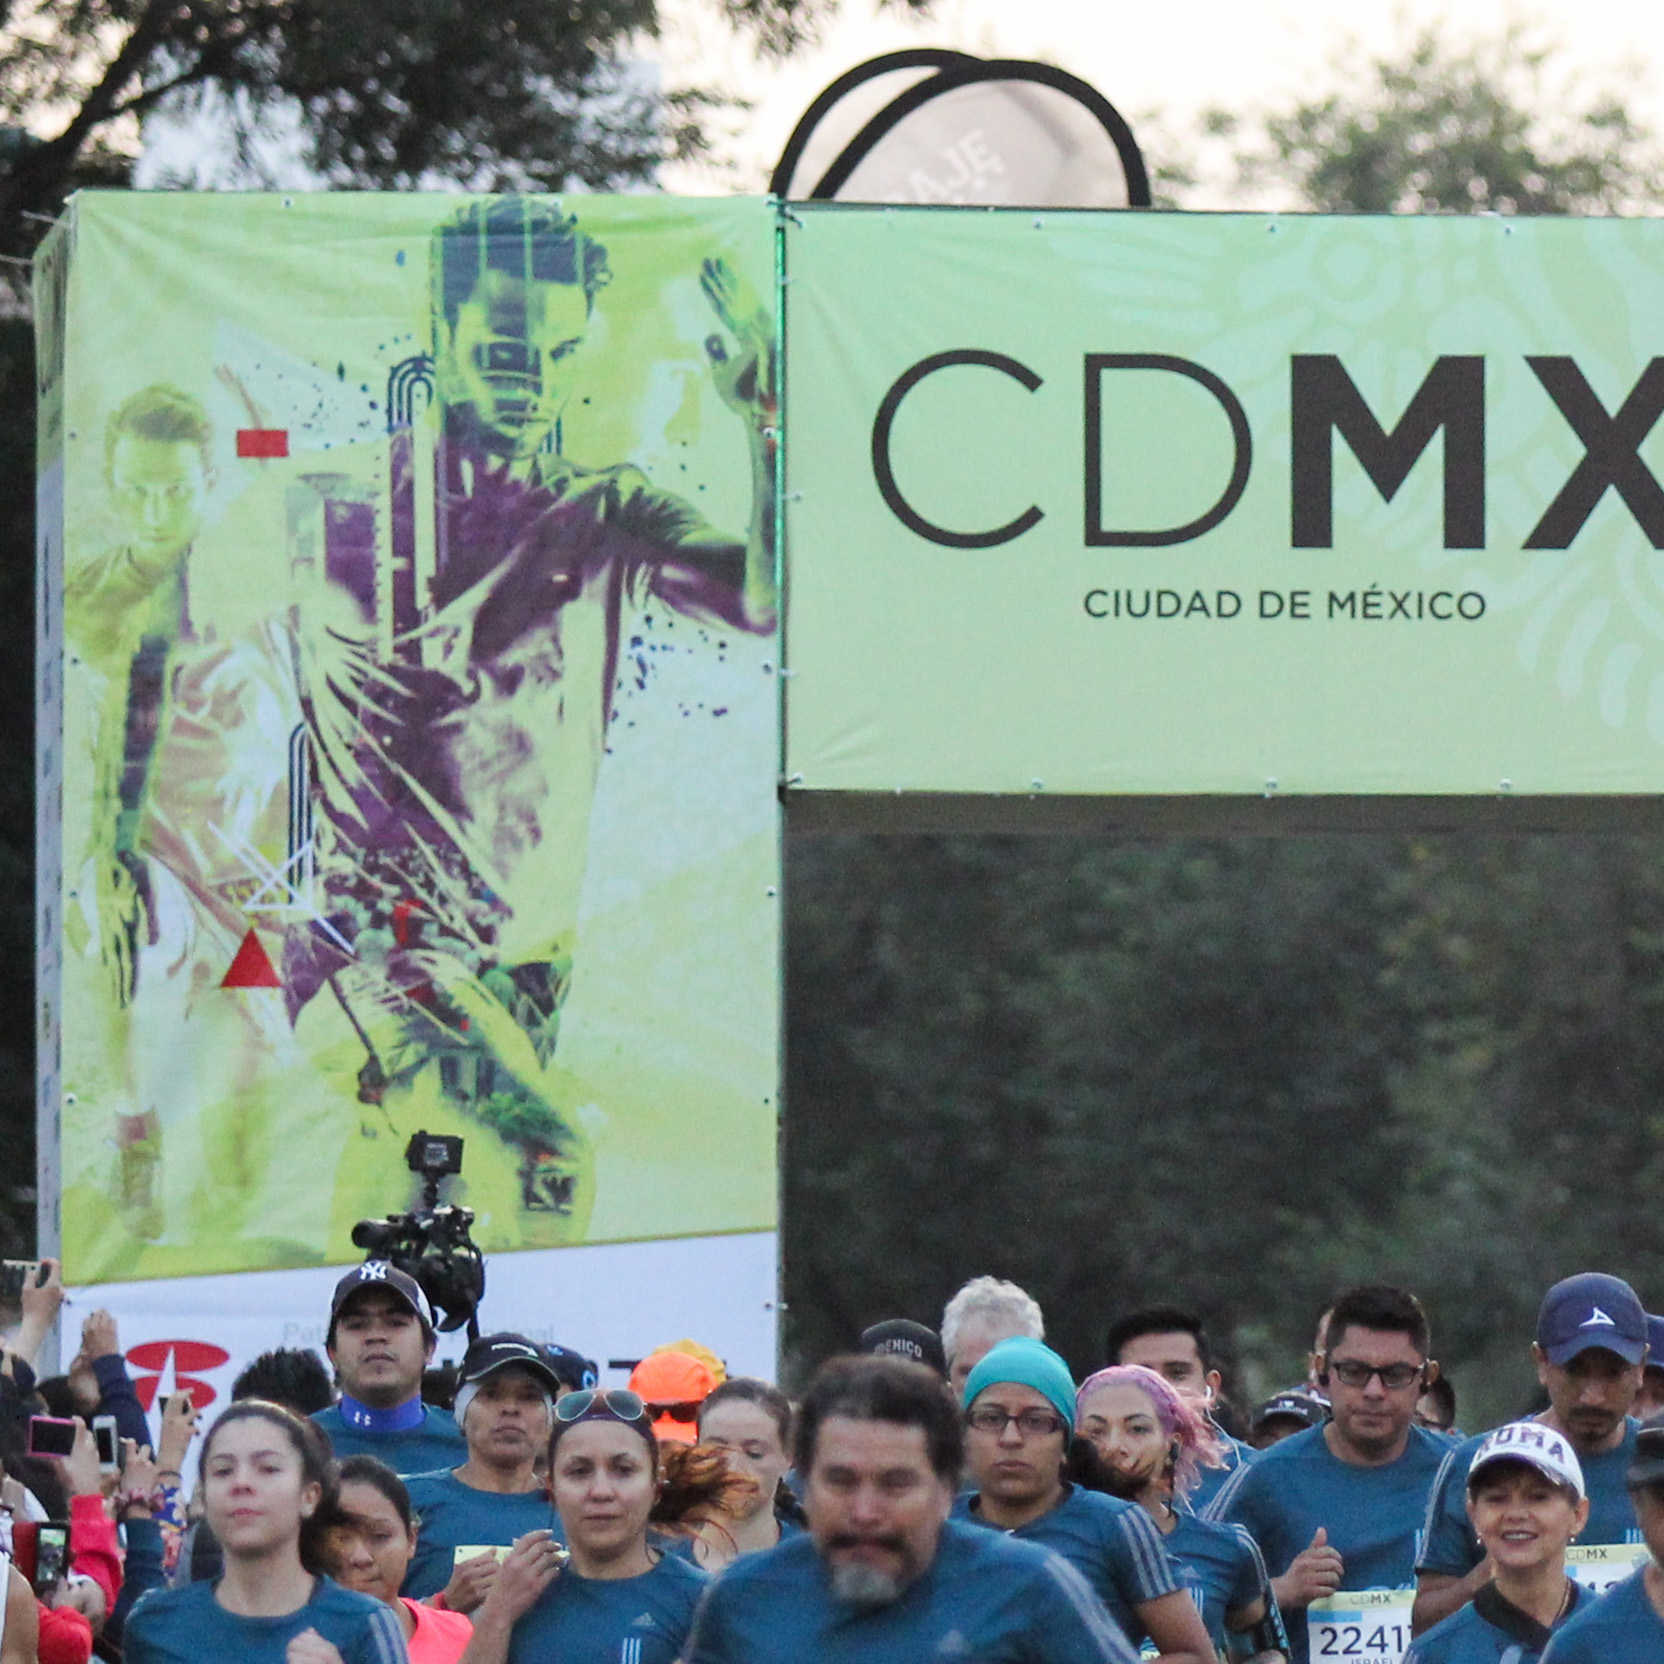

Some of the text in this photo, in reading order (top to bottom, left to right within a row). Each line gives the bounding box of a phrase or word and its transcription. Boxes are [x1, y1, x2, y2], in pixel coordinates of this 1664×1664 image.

[1083, 583, 1487, 620] CIUDAD DE MÉXICO
[1320, 1624, 1413, 1656] 2241
